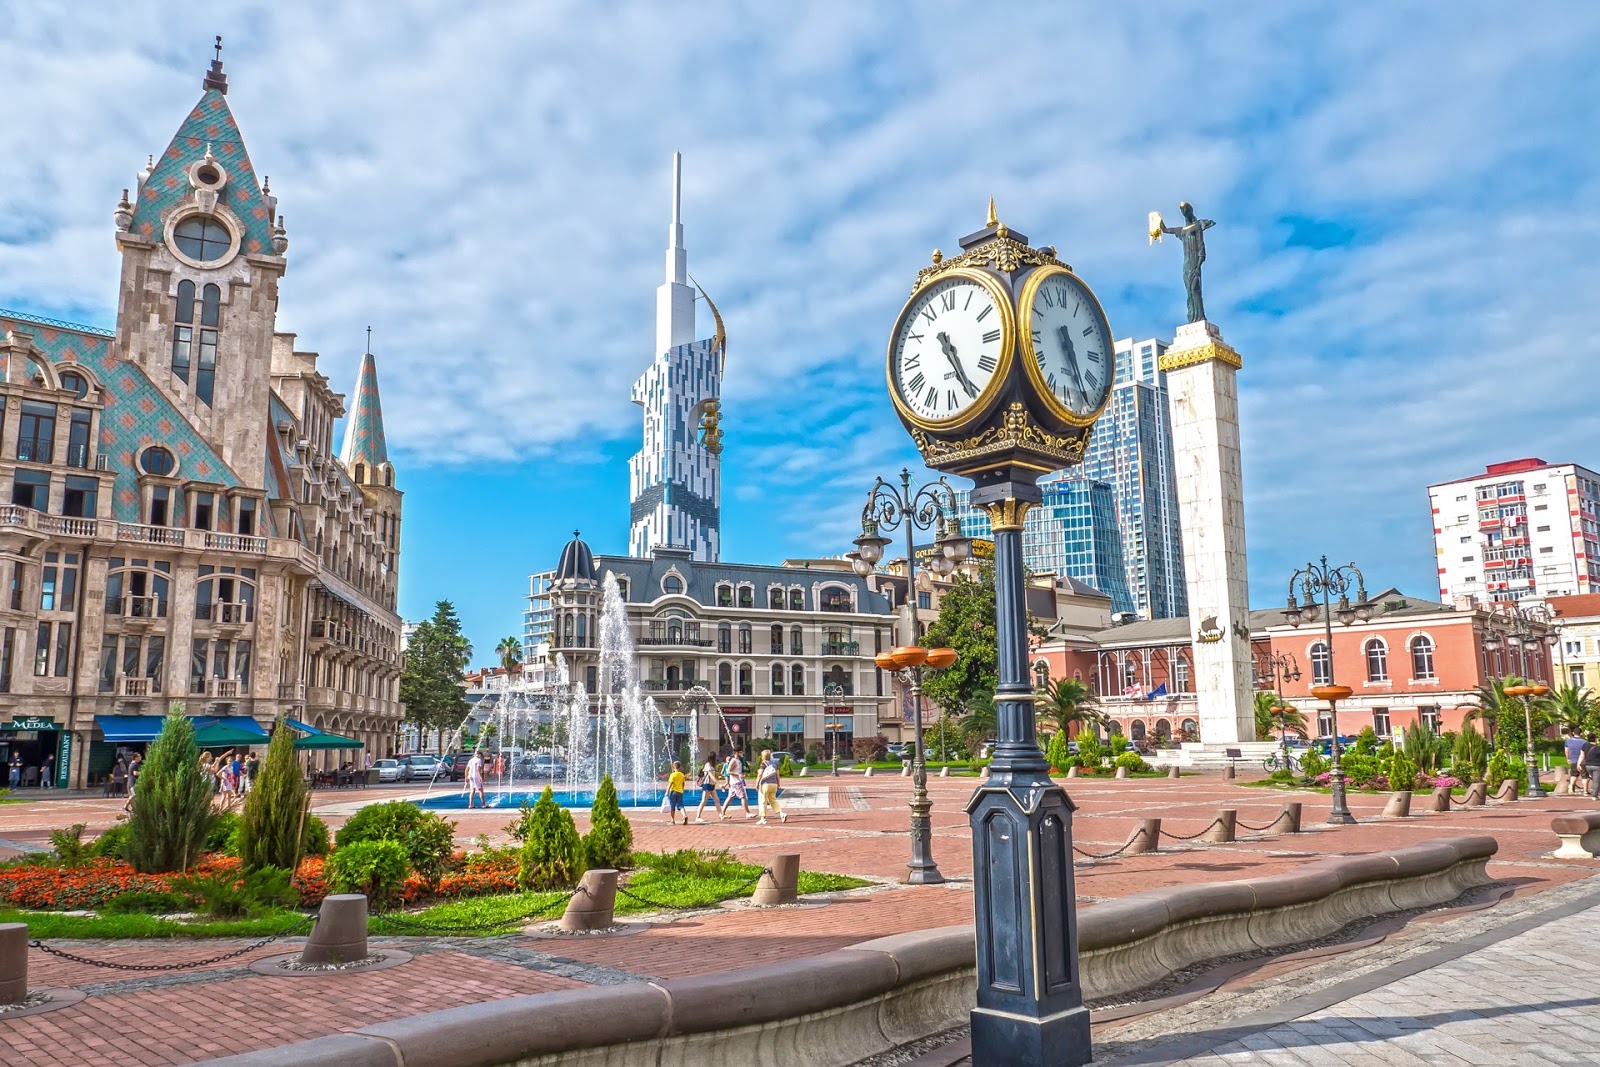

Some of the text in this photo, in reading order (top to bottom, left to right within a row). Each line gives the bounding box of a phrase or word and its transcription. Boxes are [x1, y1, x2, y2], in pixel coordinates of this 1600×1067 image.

[941, 290, 956, 314] XII
[1040, 286, 1053, 310] XI
[1055, 286, 1067, 310] XII
[921, 303, 938, 327] XI
[976, 304, 993, 323] II
[908, 330, 924, 344] X
[982, 329, 1000, 344] III
[1082, 326, 1094, 338] II
[904, 353, 920, 371] IX
[1087, 350, 1100, 364] III
[908, 371, 926, 398] VIII
[924, 386, 939, 410] VII
[948, 389, 959, 411] VI
[12, 720, 54, 730] MEDEA
[60, 735, 70, 780] RESTAURANT
